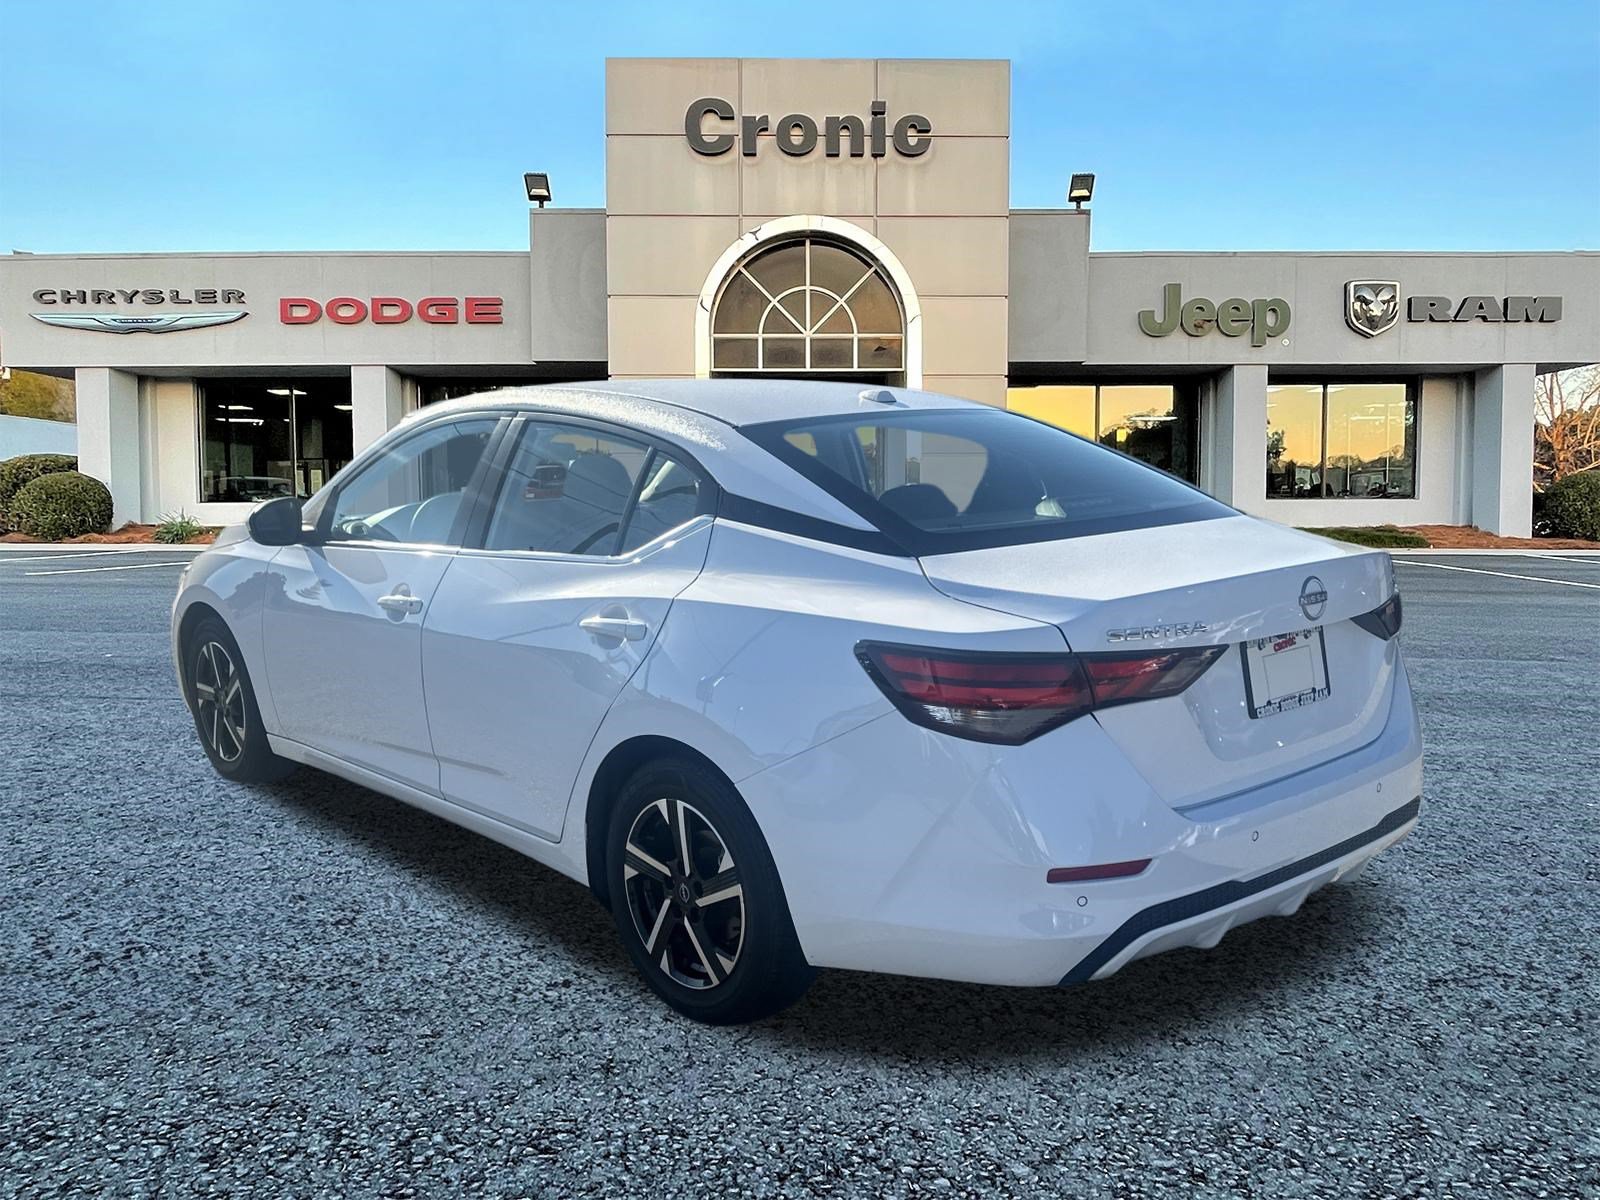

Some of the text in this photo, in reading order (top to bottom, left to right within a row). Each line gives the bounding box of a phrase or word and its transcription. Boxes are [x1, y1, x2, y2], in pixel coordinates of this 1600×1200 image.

[685, 98, 932, 157] Cronic
[32, 288, 247, 305] CHRYSLER
[279, 296, 504, 325] DODGE
[1407, 296, 1563, 323] RAM
[1138, 283, 1291, 347] Jeep
[1106, 621, 1209, 643] SENTRA
